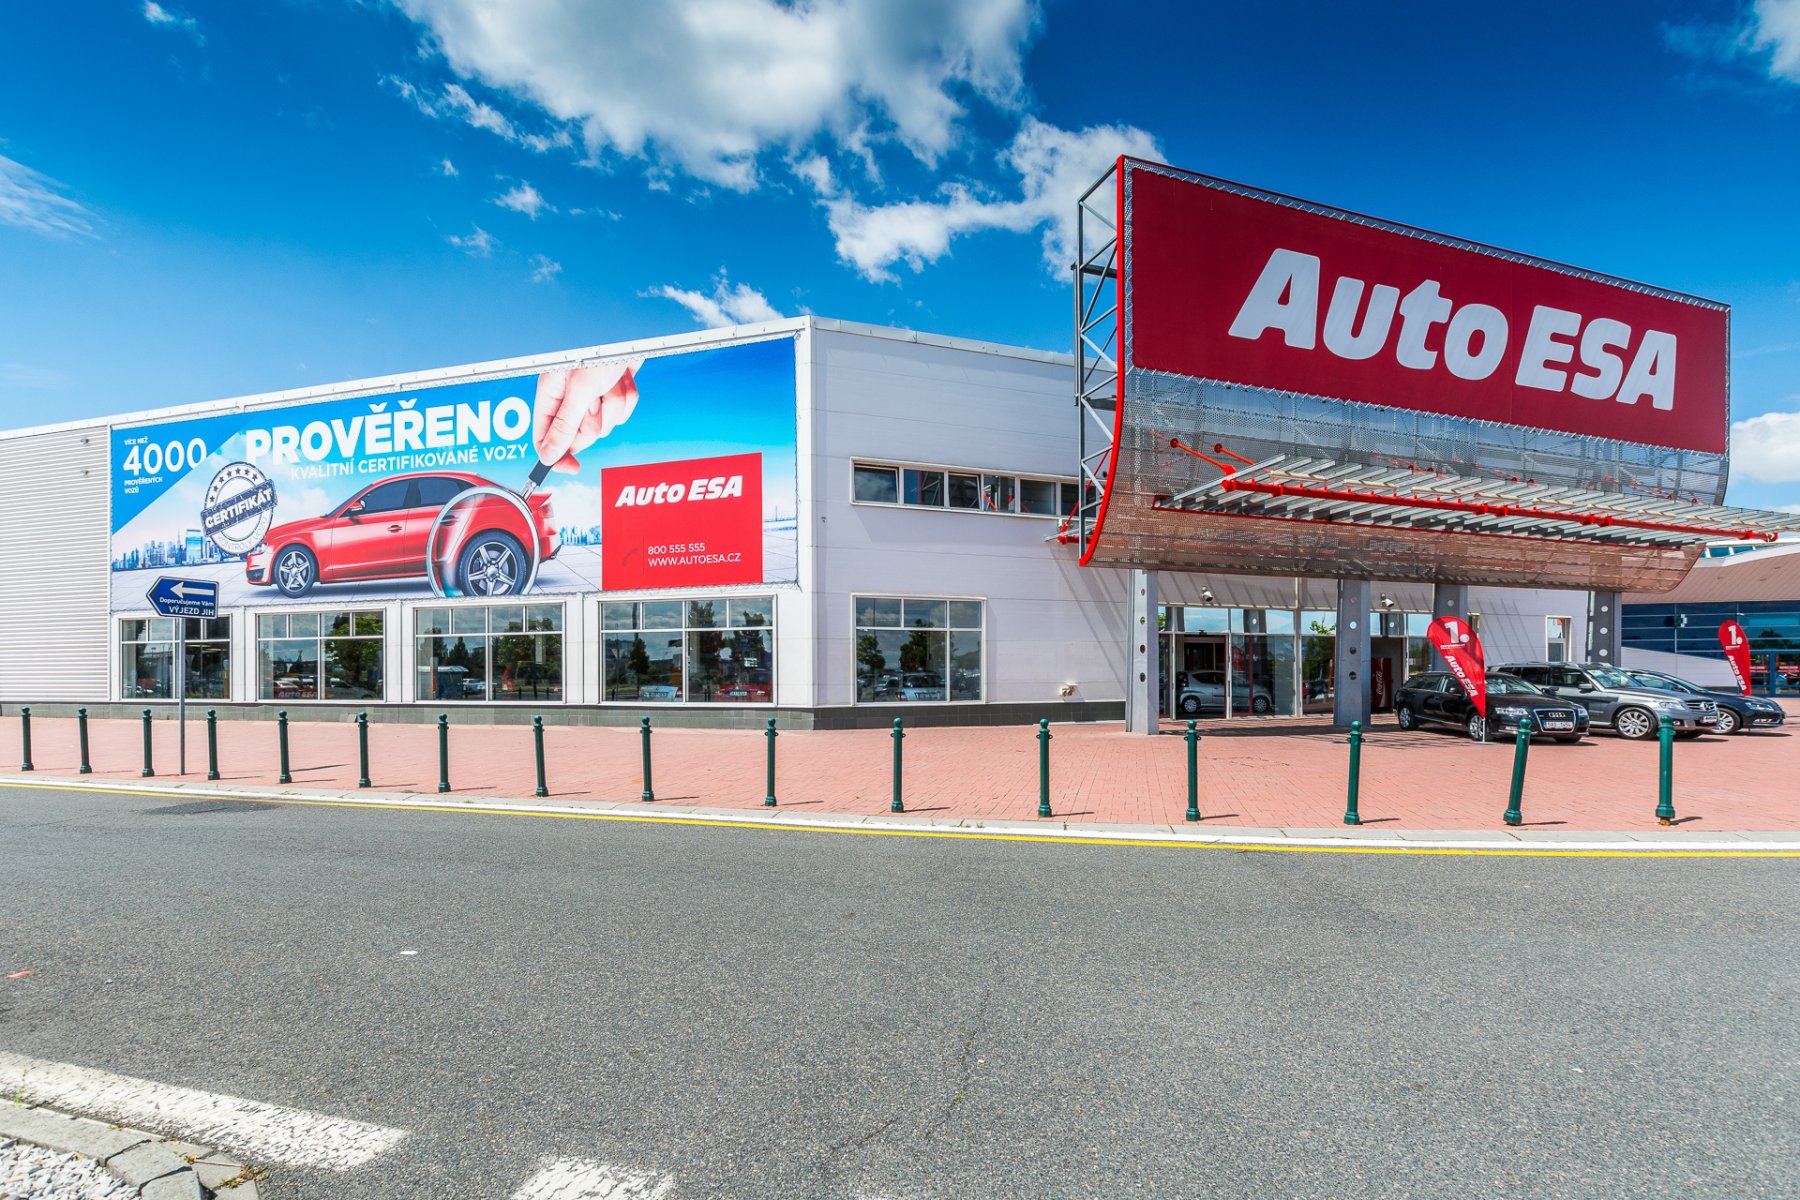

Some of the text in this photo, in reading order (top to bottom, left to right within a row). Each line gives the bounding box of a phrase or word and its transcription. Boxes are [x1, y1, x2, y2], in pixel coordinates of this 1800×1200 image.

[1228, 248, 1677, 411] Auto ESA
[246, 397, 531, 467] PROVĚŘENO
[123, 437, 207, 476] 4000
[290, 443, 528, 480] KVALITNÍ CERTIFIKOVANÉ VOZY
[204, 488, 273, 529] CERTIFIKÁT
[614, 475, 743, 508] Auto ESA
[647, 542, 706, 555] 800 555 555
[648, 552, 741, 567] WWW.AUTOESA.CZ
[160, 597, 200, 606] Doporučujeme
[169, 605, 199, 614] VÝJEZD
[1444, 655, 1466, 678] Auto
[1461, 678, 1479, 697] ESA
